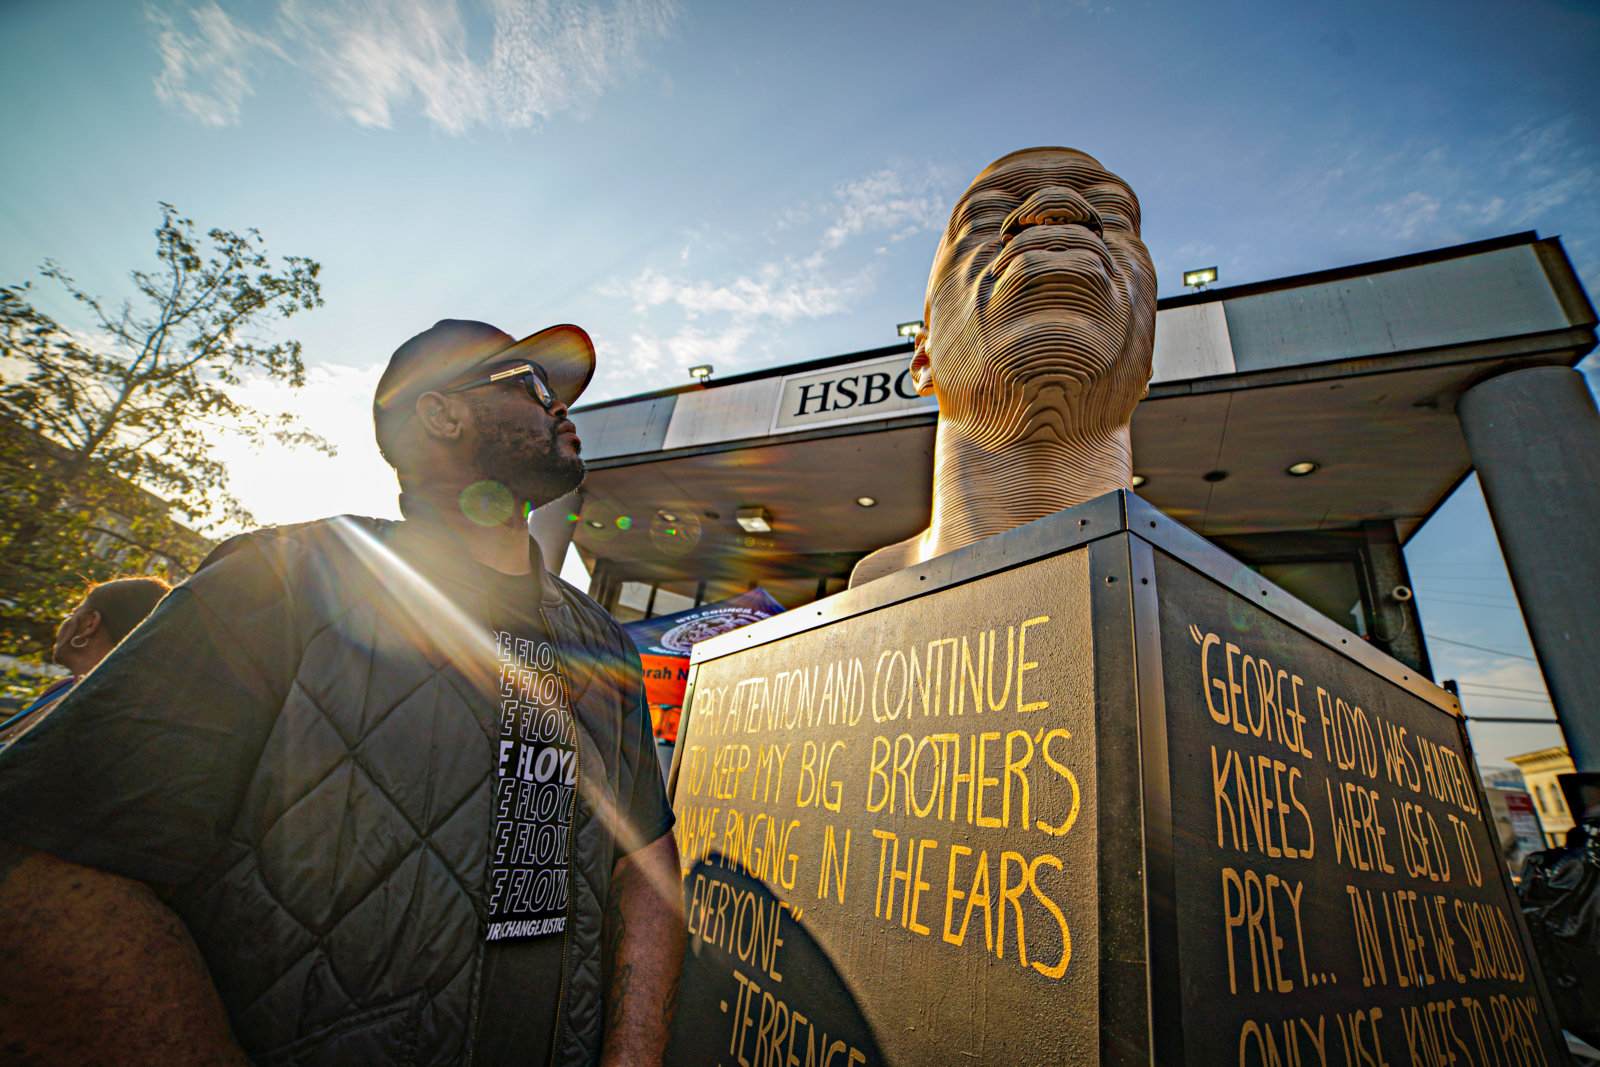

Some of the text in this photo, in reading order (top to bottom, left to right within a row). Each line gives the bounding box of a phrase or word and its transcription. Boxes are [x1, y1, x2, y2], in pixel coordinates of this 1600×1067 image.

[793, 368, 921, 417] HSBC
[702, 607, 753, 617] COUNCIL
[722, 668, 817, 734] ATTENTION
[815, 659, 865, 727] AND
[871, 615, 1050, 723] CONTINUE
[1189, 624, 1312, 759] "GEORGE
[1316, 686, 1378, 779] FLOYD
[1377, 716, 1421, 793] WAS
[688, 727, 1081, 837] TO KEEP MY BIG BROTHER'S
[1211, 744, 1482, 888] KNEES WERE USED TO
[677, 806, 1072, 979] NAME RINGING IN THE EARS
[688, 874, 803, 982] EVERYONE"
[1346, 885, 1387, 988] IN
[1383, 890, 1436, 988] LIFE
[1424, 895, 1466, 984] WE
[1454, 899, 1526, 984] SHOULD
